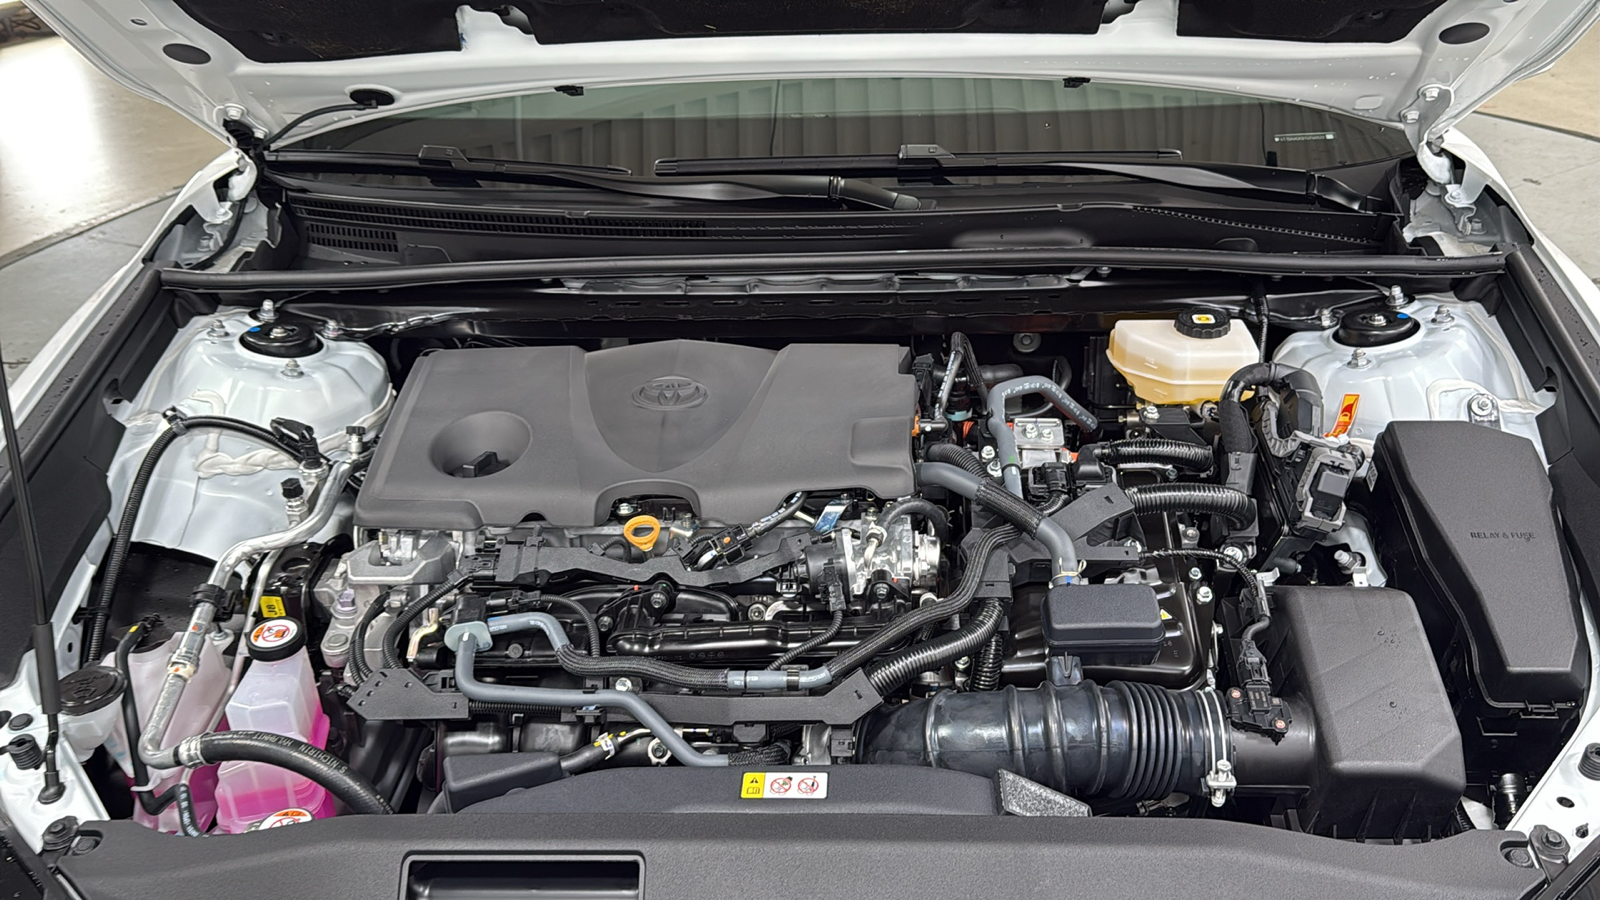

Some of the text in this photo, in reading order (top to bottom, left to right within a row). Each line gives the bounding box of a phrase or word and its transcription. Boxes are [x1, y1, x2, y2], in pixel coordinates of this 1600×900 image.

[1470, 531, 1500, 539] RELAY
[1510, 531, 1536, 540] FUSE
[298, 743, 340, 769] NICHIRIN
